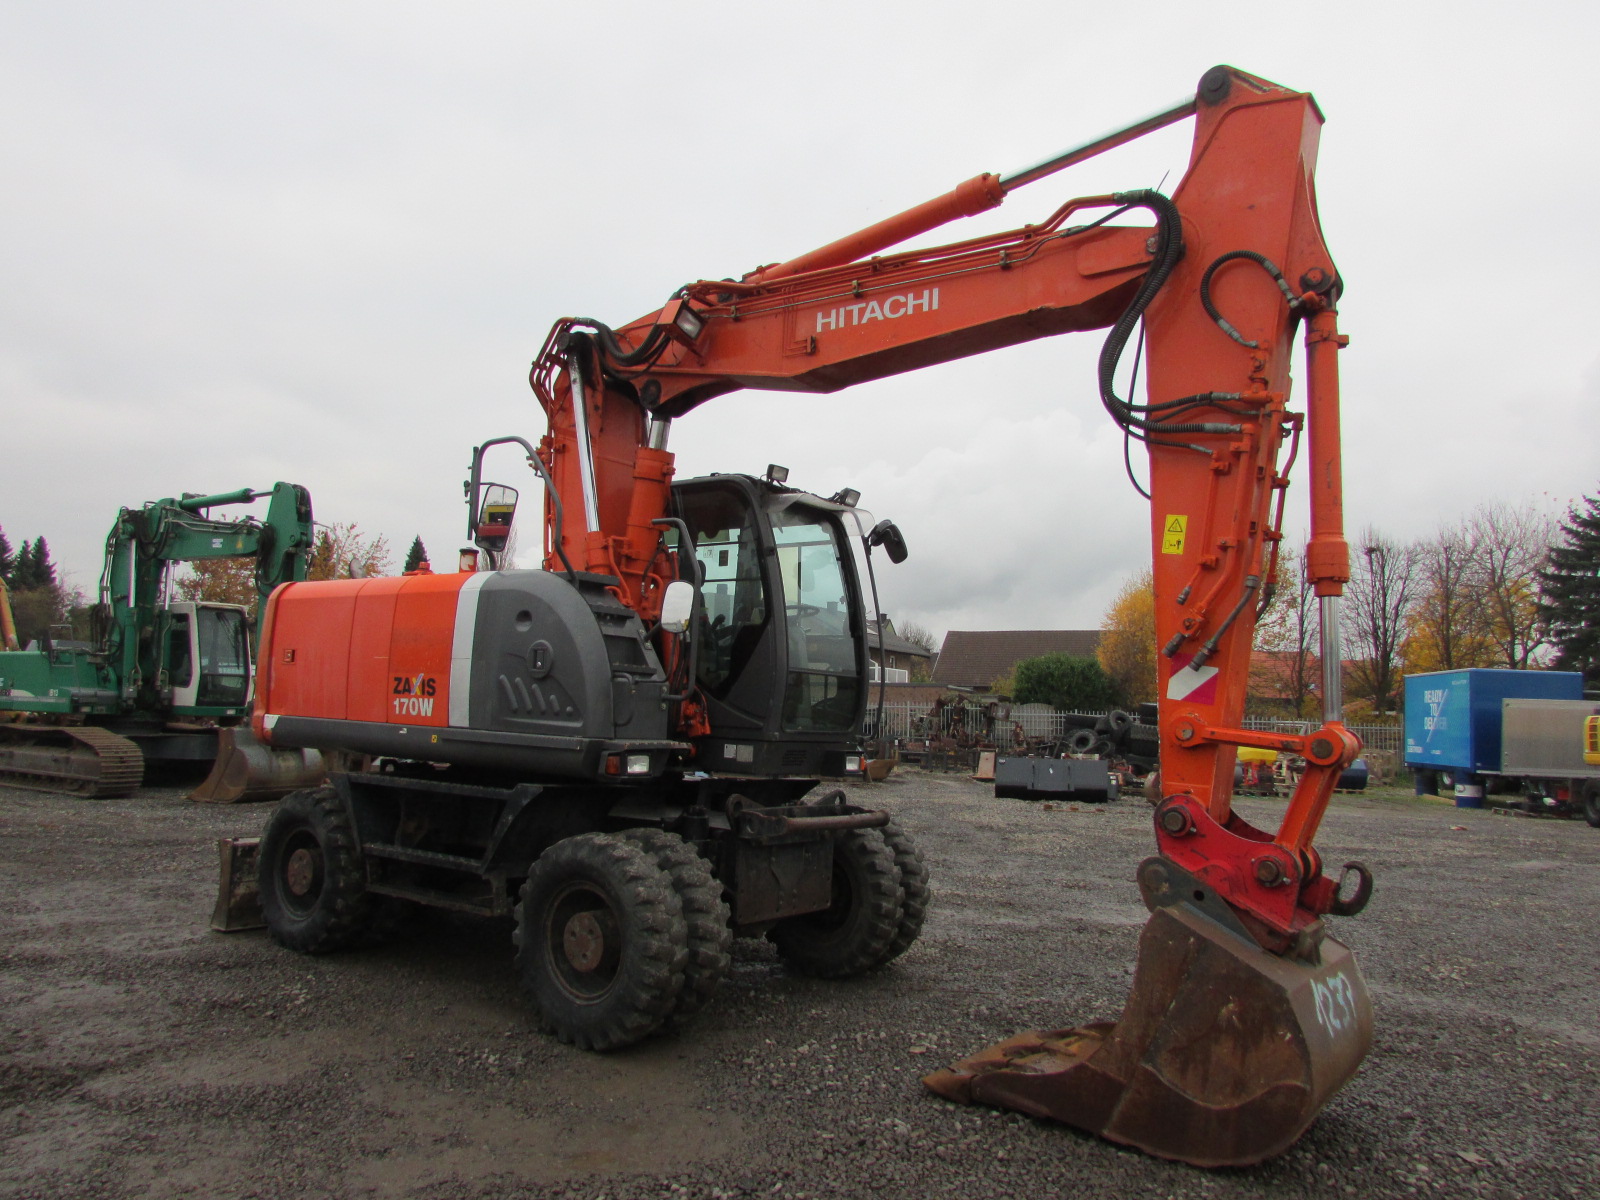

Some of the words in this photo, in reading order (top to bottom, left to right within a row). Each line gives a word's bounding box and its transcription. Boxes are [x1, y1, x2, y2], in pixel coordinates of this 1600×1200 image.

[816, 287, 940, 333] HITACHI
[393, 673, 437, 697] ZAXIS
[393, 697, 434, 717] 170W
